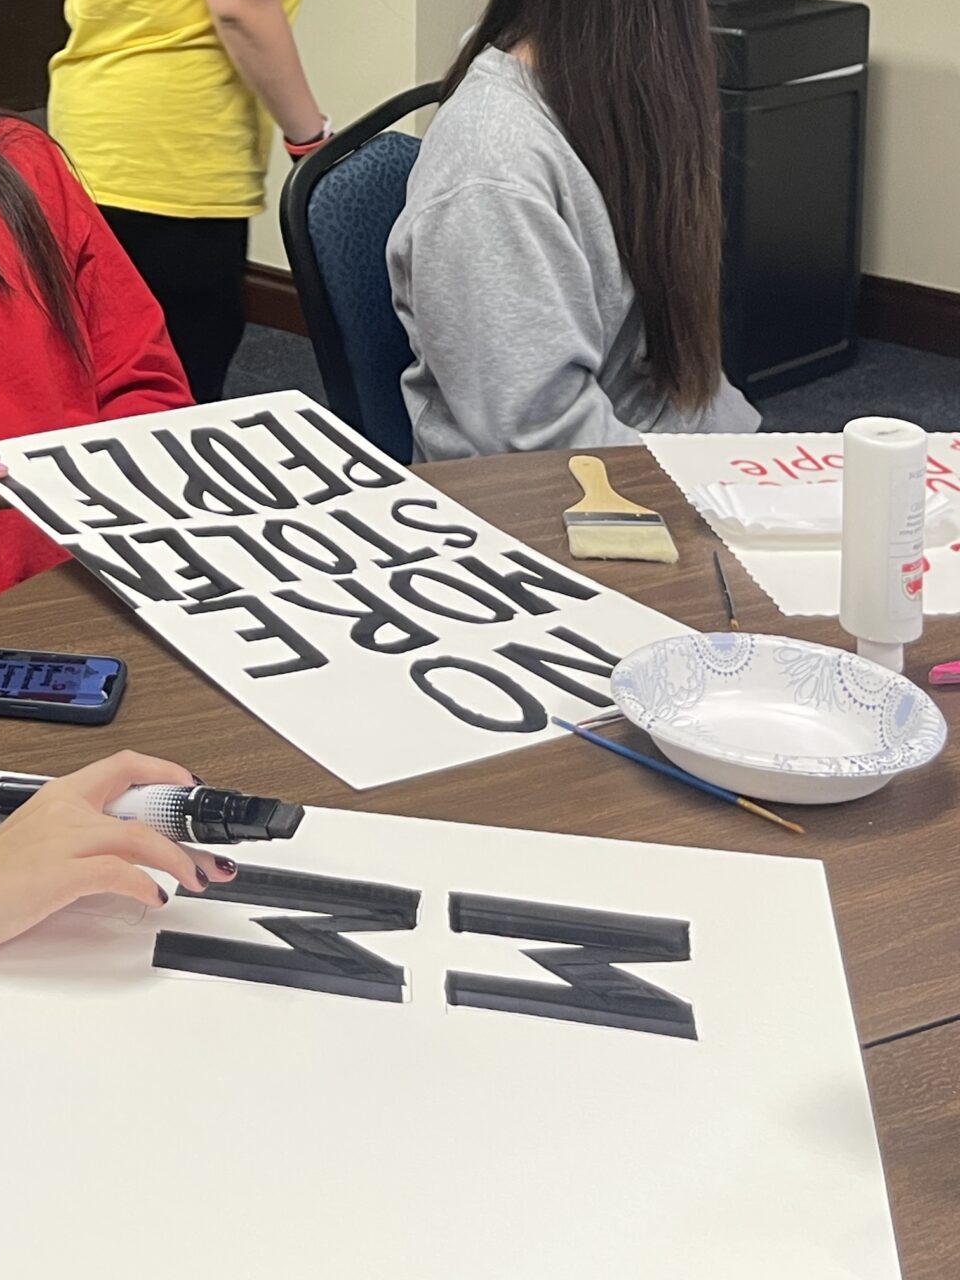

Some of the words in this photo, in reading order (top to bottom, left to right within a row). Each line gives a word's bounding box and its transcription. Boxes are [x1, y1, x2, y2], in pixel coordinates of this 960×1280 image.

[61, 499, 478, 612] STOLEN
[180, 551, 601, 679] MORE
[409, 625, 622, 734] NO
